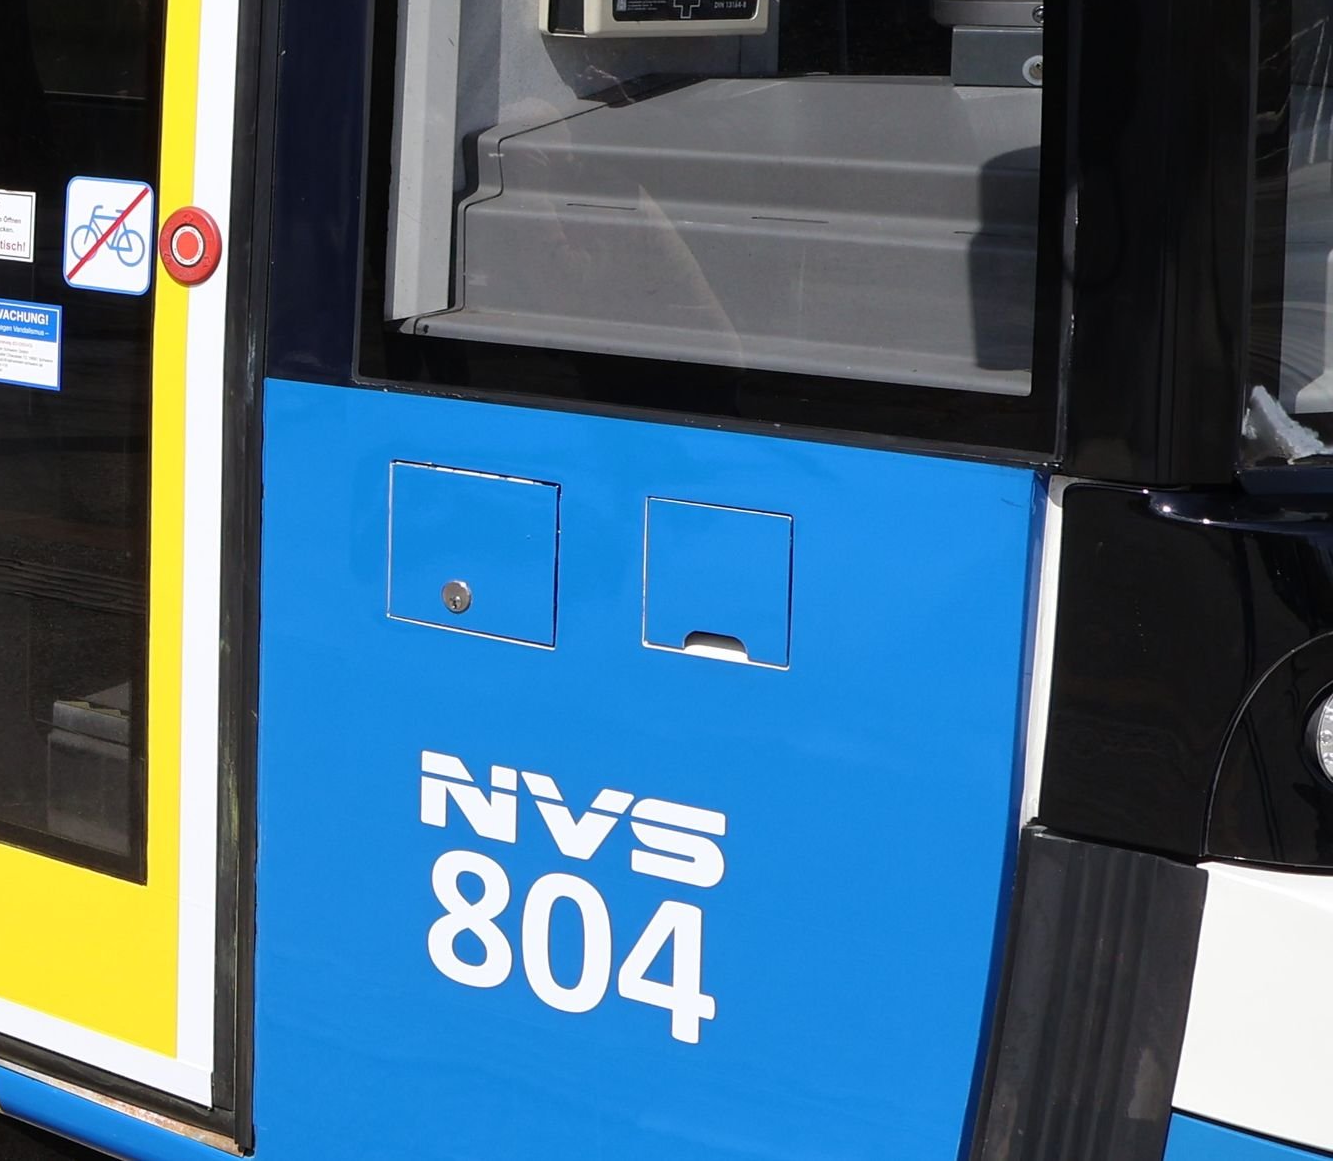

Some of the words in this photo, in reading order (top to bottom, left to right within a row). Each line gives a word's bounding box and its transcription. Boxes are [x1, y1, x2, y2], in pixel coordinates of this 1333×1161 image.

[13, 325, 45, 336] Vandalismus
[420, 749, 727, 889] NVS
[427, 848, 716, 1045] 804
